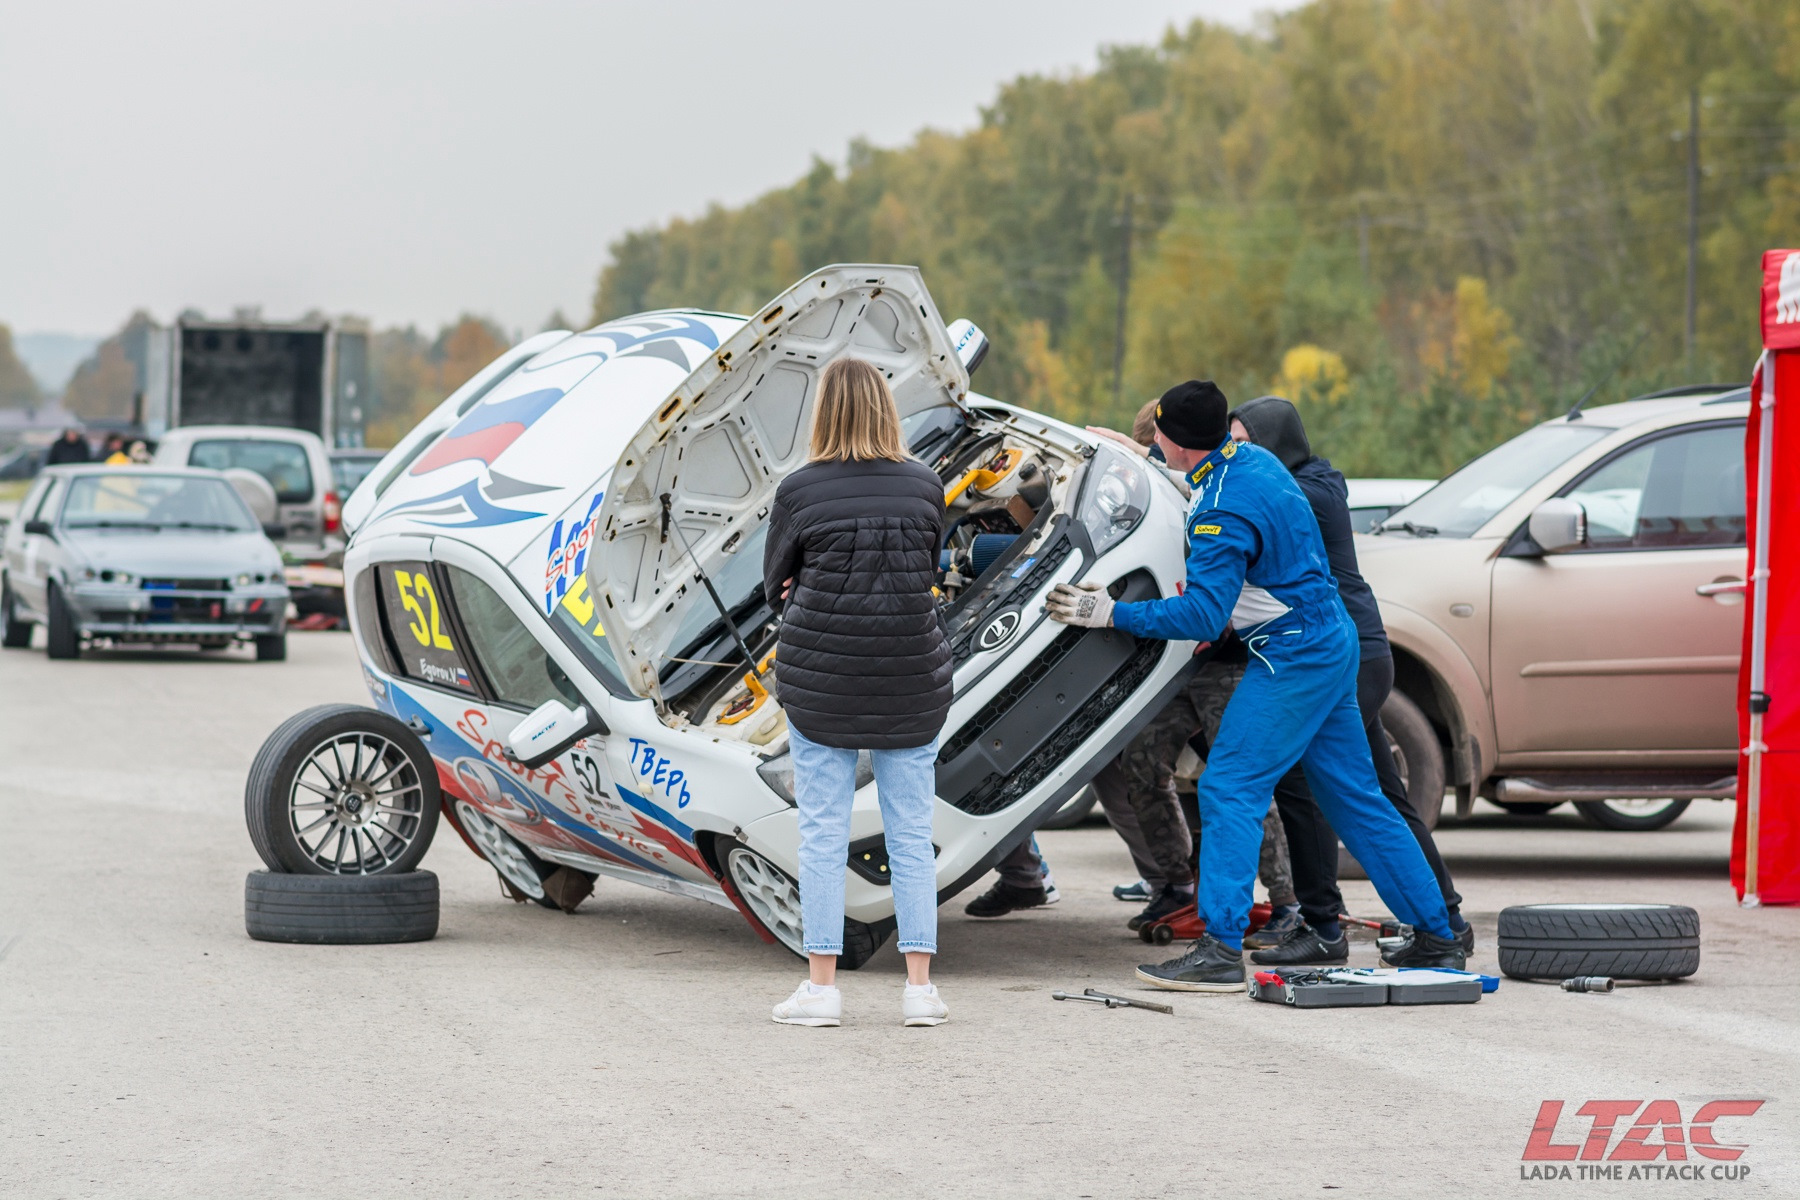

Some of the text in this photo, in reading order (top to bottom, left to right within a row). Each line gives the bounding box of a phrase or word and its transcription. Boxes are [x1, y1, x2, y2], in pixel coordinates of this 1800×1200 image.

[394, 569, 454, 652] 52
[570, 752, 611, 800] 52
[629, 737, 691, 809] ТВЕРЬ
